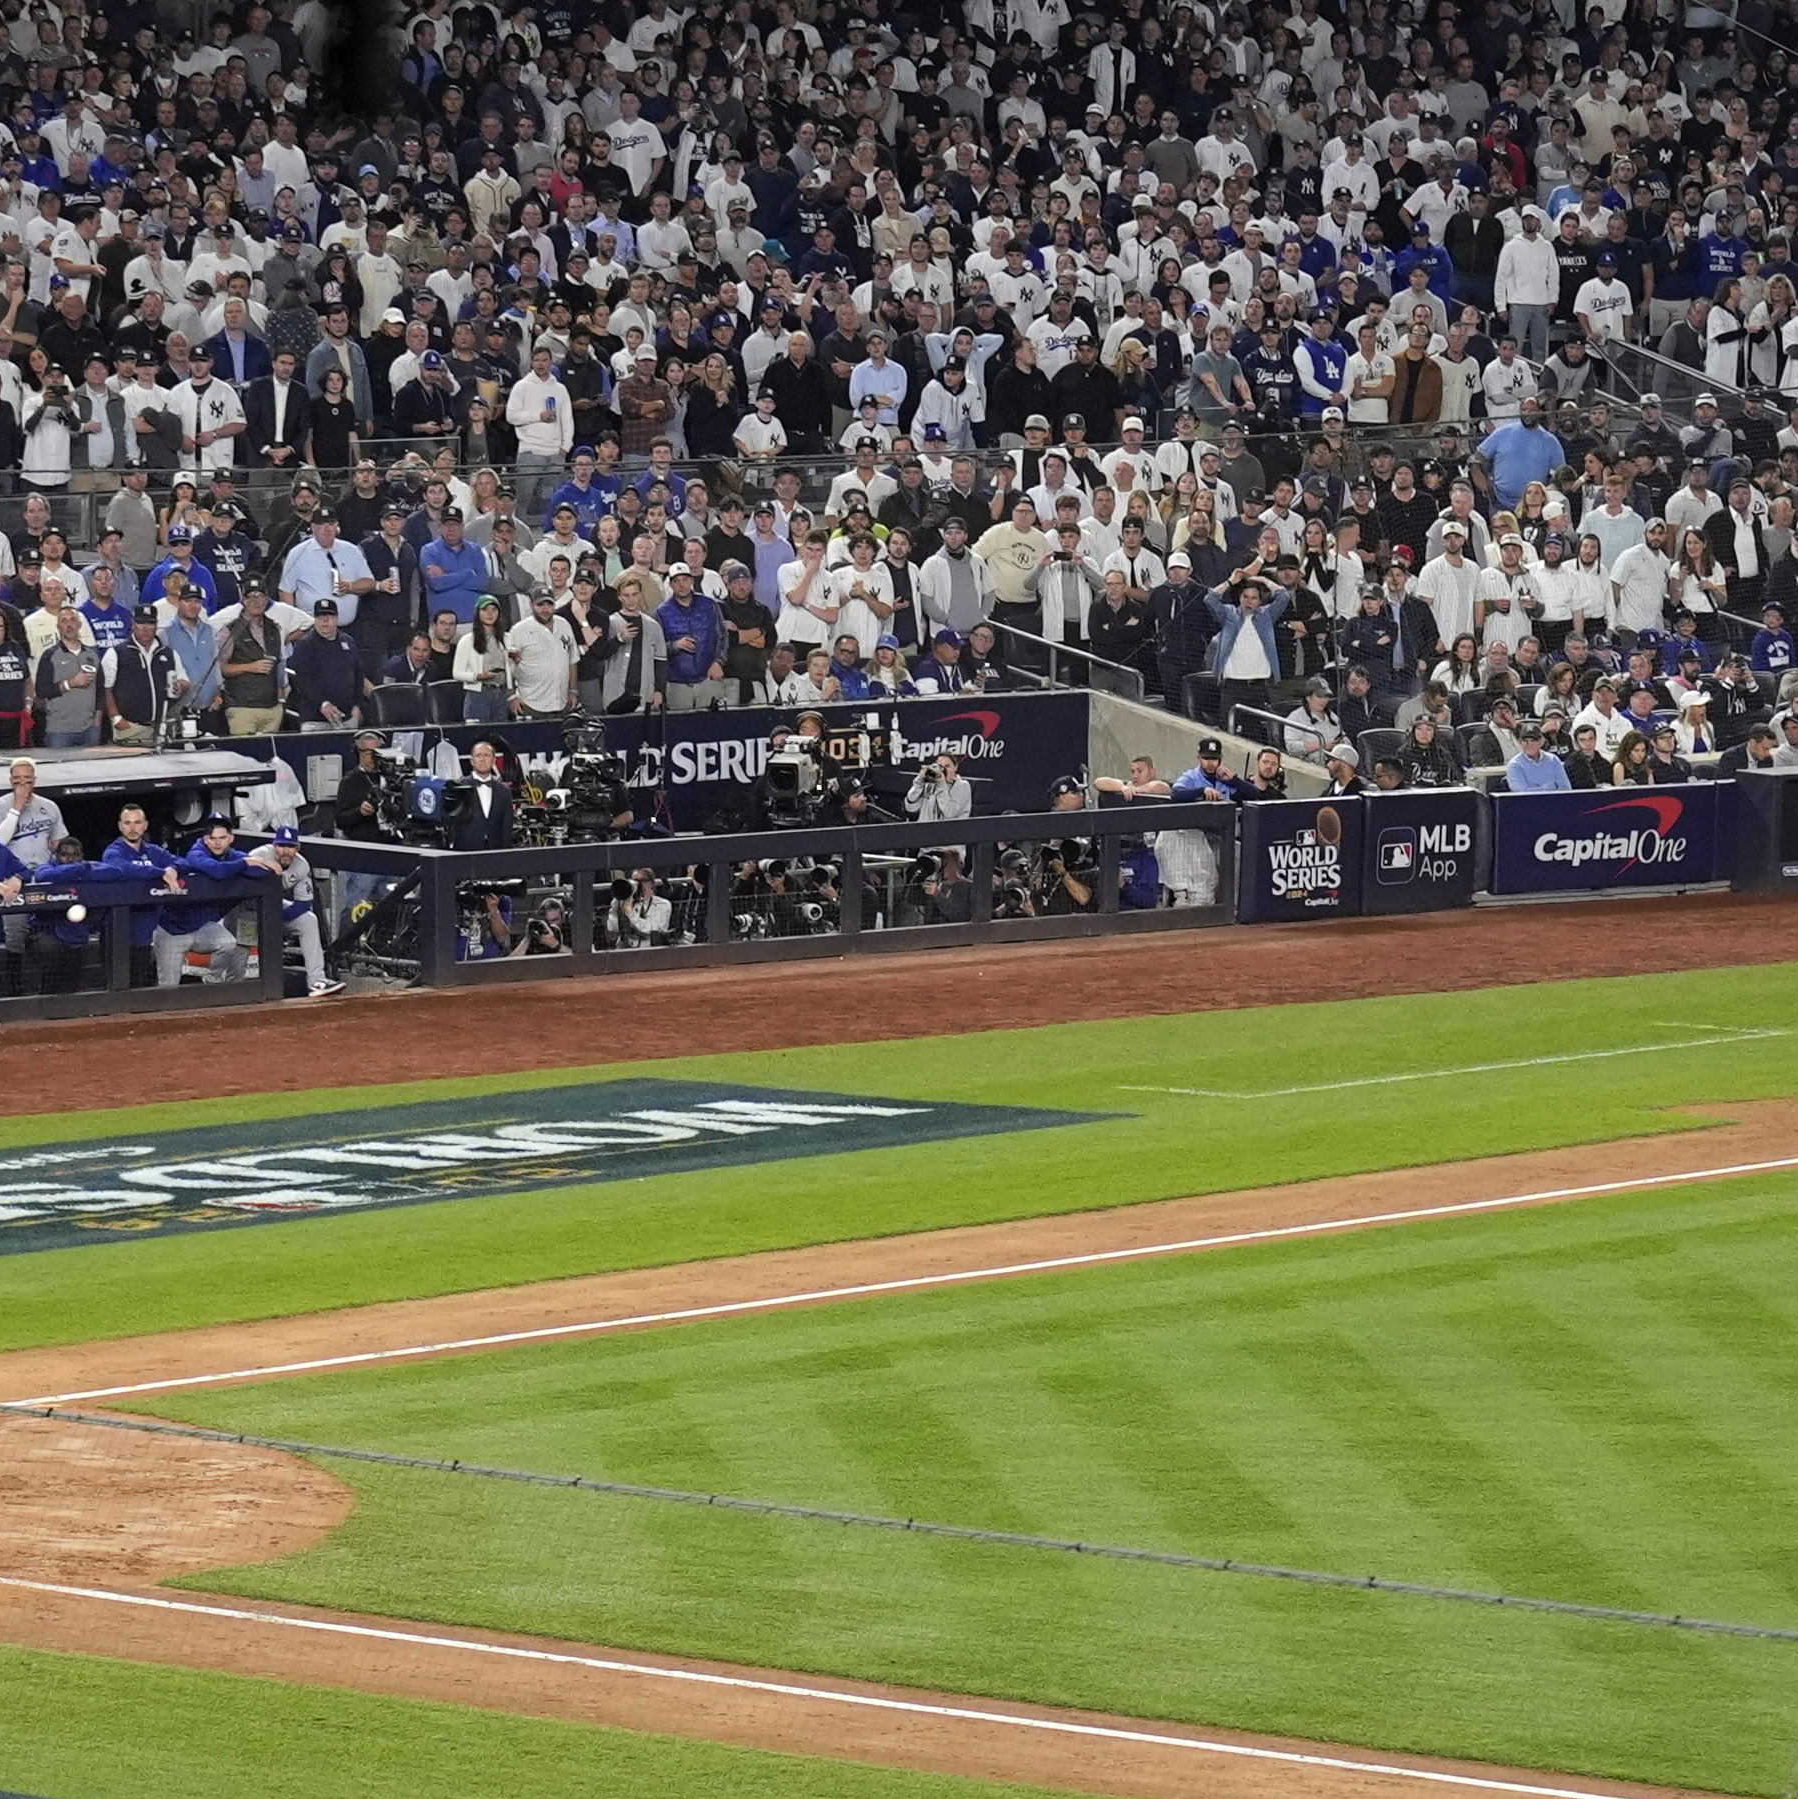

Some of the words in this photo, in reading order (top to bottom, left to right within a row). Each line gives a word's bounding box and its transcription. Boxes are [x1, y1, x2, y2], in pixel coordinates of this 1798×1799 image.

[613, 133, 650, 150] Dodgers
[1591, 297, 1626, 312] Dodgers
[1323, 356, 1340, 379] LA
[1419, 824, 1471, 855] MLB
[1533, 828, 1688, 867] CapitalOne
[1268, 845, 1339, 869] WORLD
[1271, 864, 1342, 897] SERIES
[1419, 857, 1458, 882] App
